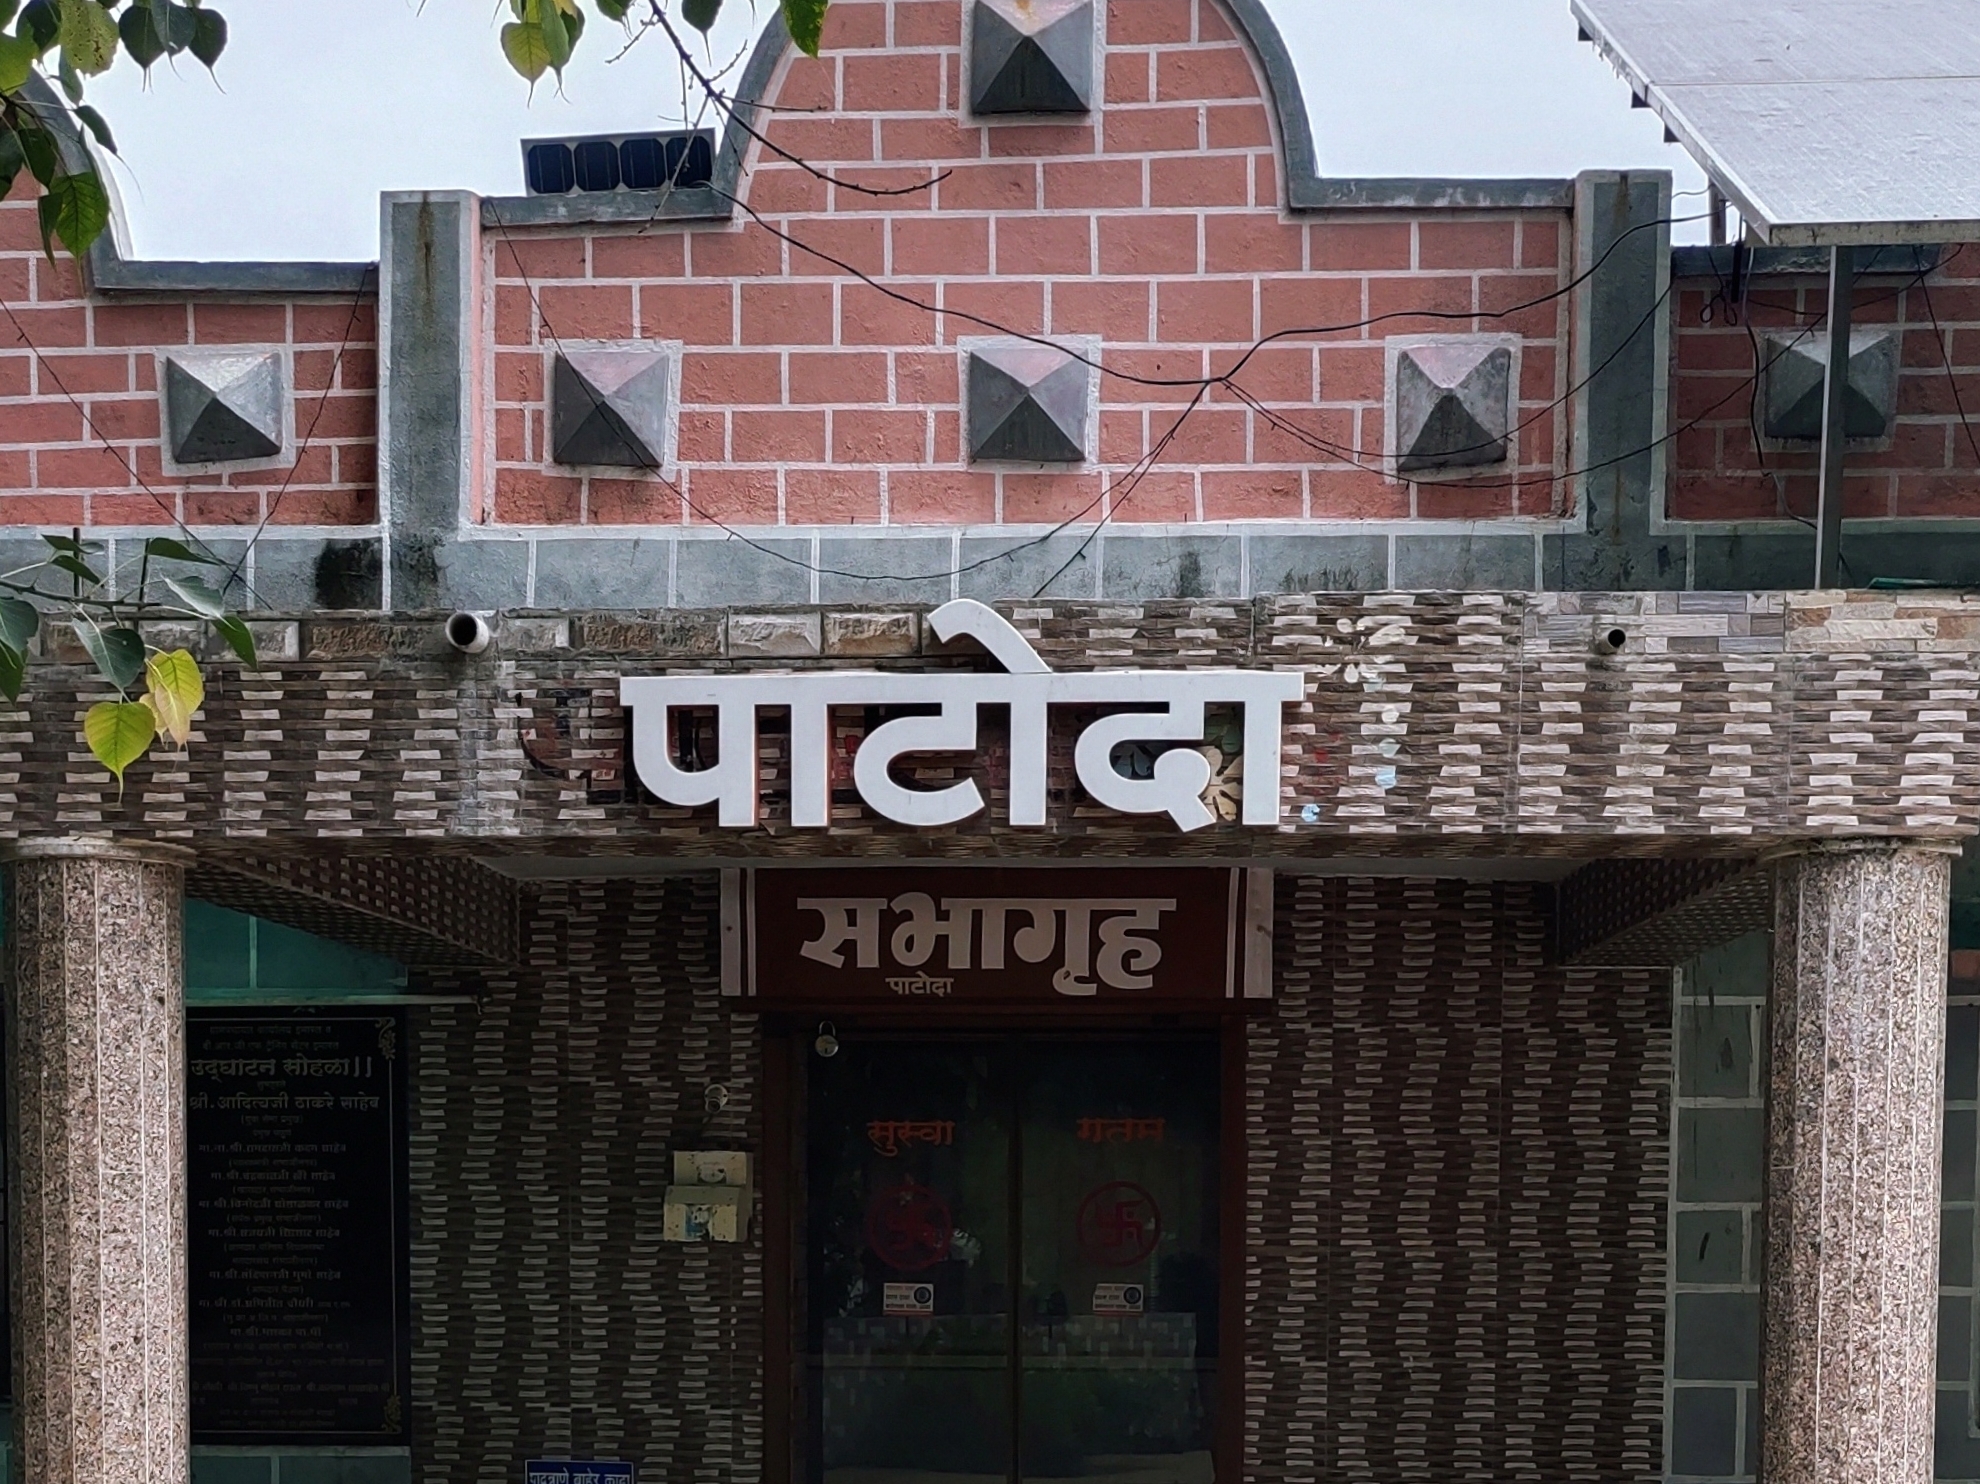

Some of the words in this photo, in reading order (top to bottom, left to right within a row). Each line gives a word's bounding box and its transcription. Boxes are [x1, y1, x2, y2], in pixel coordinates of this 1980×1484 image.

[620, 598, 1304, 832] पाटोदा
[798, 892, 1176, 995] सभागृह
[885, 971, 955, 997] पाटोदा
[294, 1092, 334, 1110] ठाकरे
[340, 1092, 380, 1111] साहेब
